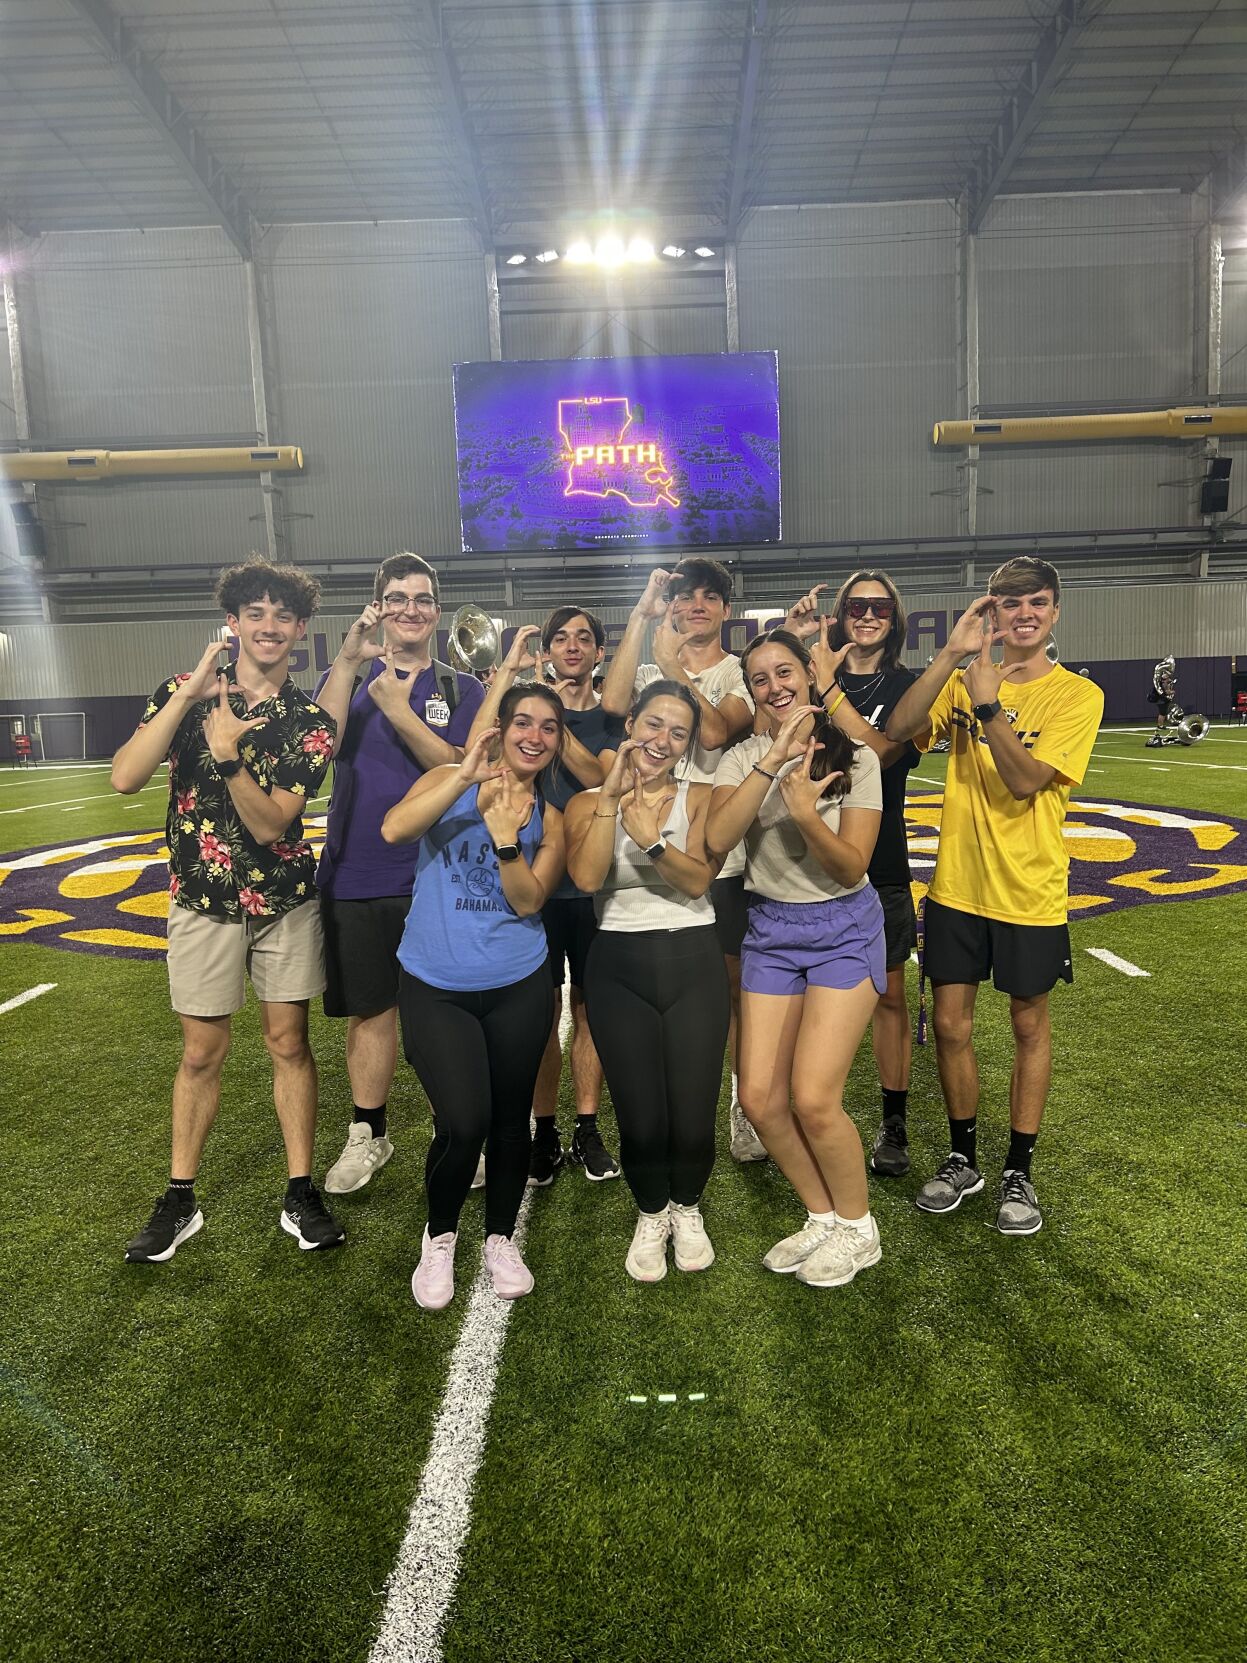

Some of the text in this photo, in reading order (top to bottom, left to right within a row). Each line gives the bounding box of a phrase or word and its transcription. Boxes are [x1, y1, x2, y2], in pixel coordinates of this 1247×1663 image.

[584, 397, 602, 405] LSU
[576, 444, 656, 466] PATH
[428, 708, 449, 720] WEEK
[917, 903, 925, 921] LSU
[916, 932, 925, 952] LSU
